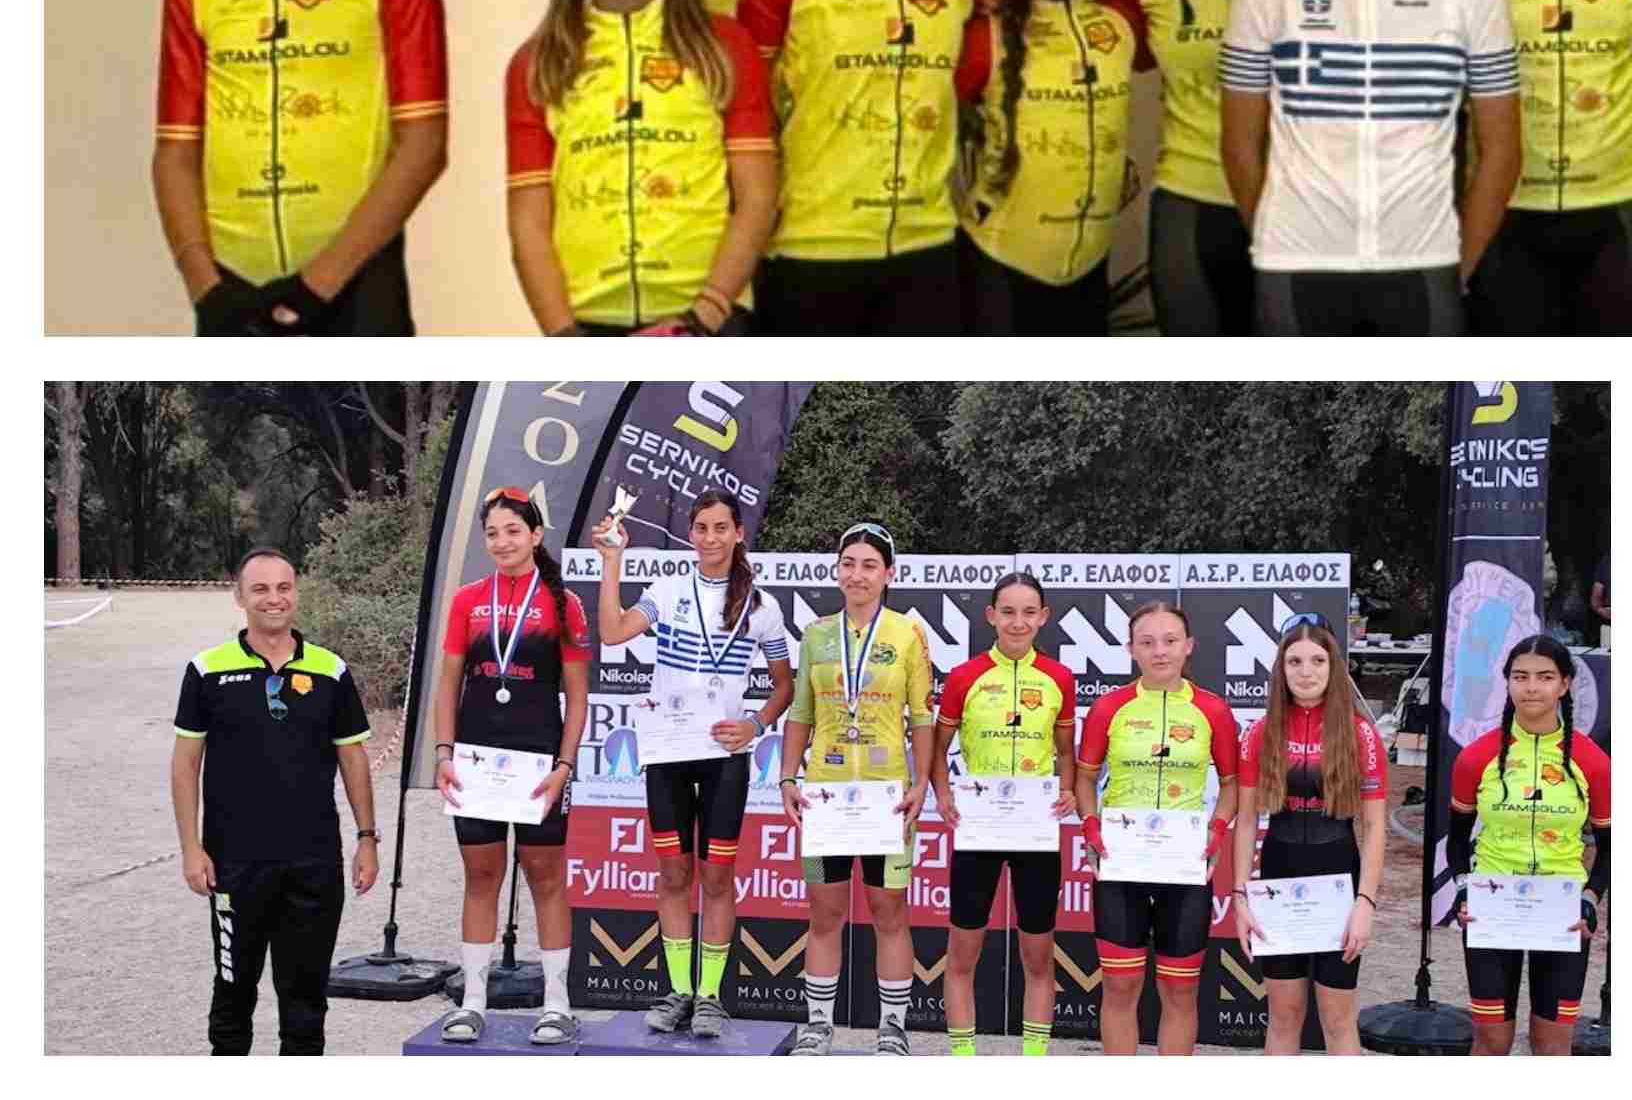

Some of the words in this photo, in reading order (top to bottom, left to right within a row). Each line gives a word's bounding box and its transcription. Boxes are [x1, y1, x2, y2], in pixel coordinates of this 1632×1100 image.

[619, 422, 761, 507] SERNIKOS
[776, 562, 839, 581] ΕΛΑΦΟ
[923, 564, 1006, 583] ΕΛΑΦΟΣ
[1085, 563, 1172, 583] ΕΛΑΦΟΣ
[1186, 563, 1245, 582] Α.Σ.Ρ.
[1252, 563, 1342, 582] ΕΛΑΦΟΣ
[600, 668, 656, 685] Nikolao
[1224, 681, 1269, 697] Nikol
[1491, 801, 1578, 815] STAMOGLOU
[567, 858, 660, 897] Fyllia
[586, 976, 659, 993] MAISON
